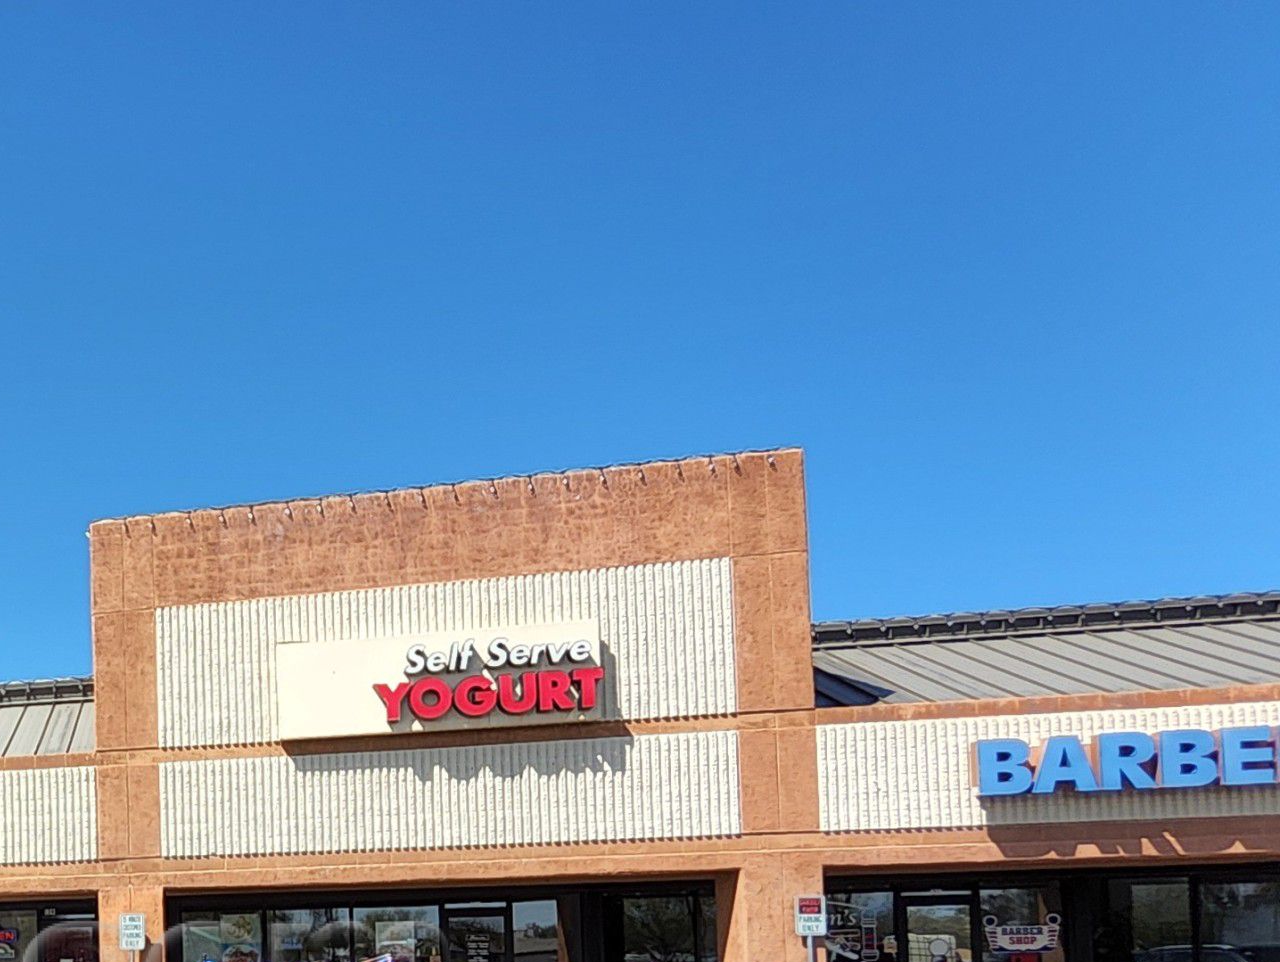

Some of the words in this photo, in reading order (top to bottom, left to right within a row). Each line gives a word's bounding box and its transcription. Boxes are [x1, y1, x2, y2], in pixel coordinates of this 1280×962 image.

[405, 638, 475, 674] Self
[486, 636, 592, 668] Serve
[373, 666, 604, 723] YOGURT
[976, 725, 1280, 797] BARBE
[1001, 927, 1044, 936] BARBER
[1008, 936, 1037, 945] SHOP
